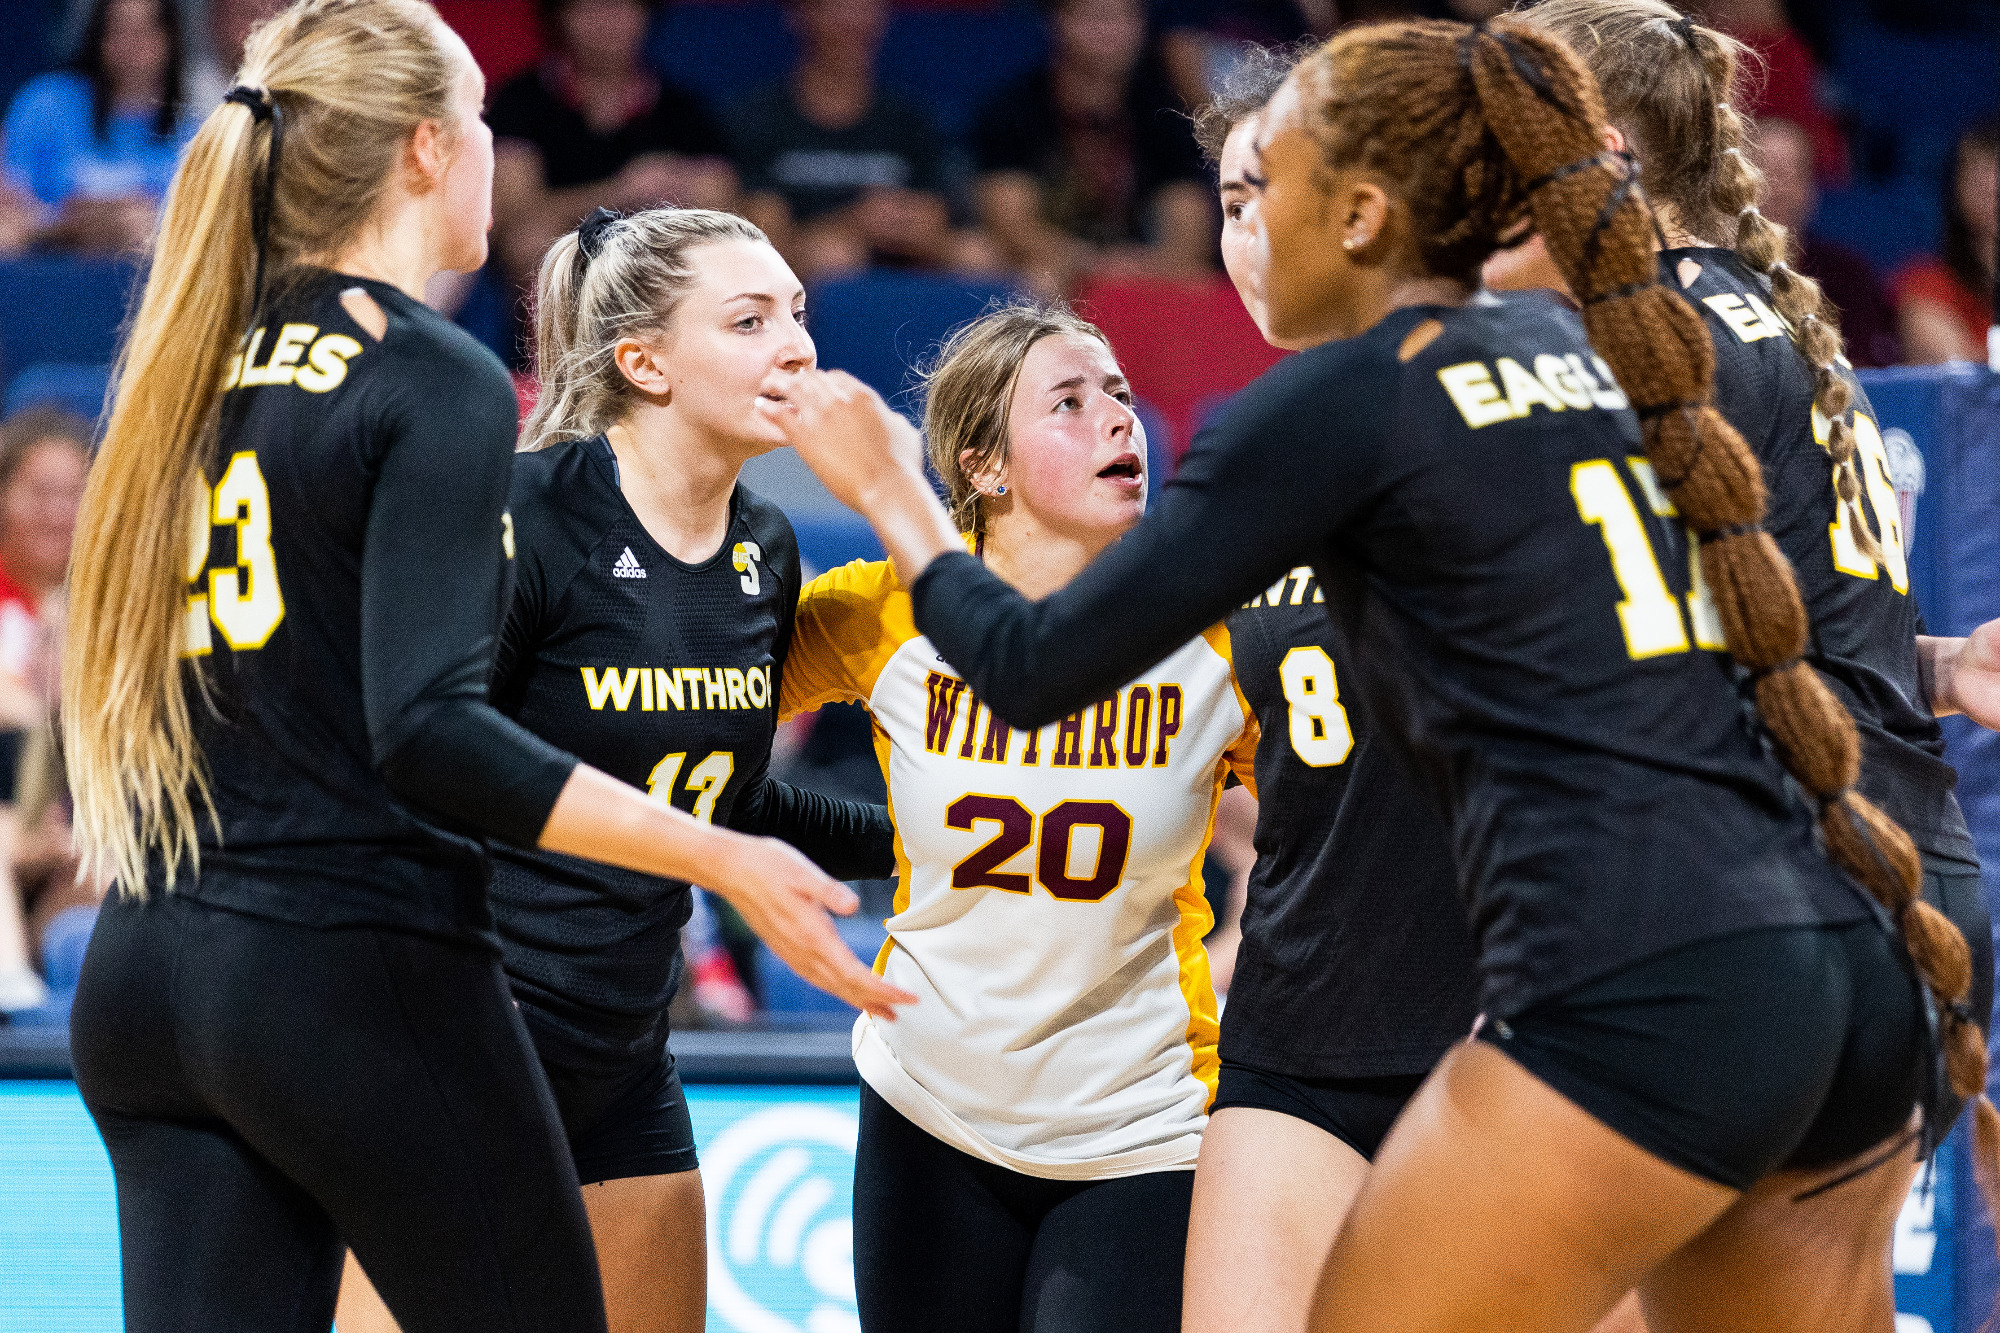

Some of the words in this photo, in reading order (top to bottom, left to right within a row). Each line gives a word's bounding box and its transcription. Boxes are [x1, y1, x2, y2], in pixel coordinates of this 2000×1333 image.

[1436, 353, 1628, 430] EAGL
[612, 564, 647, 579] adidas
[580, 664, 772, 711] WINTHRO
[1279, 645, 1355, 768] 8
[944, 791, 1134, 903] 20
